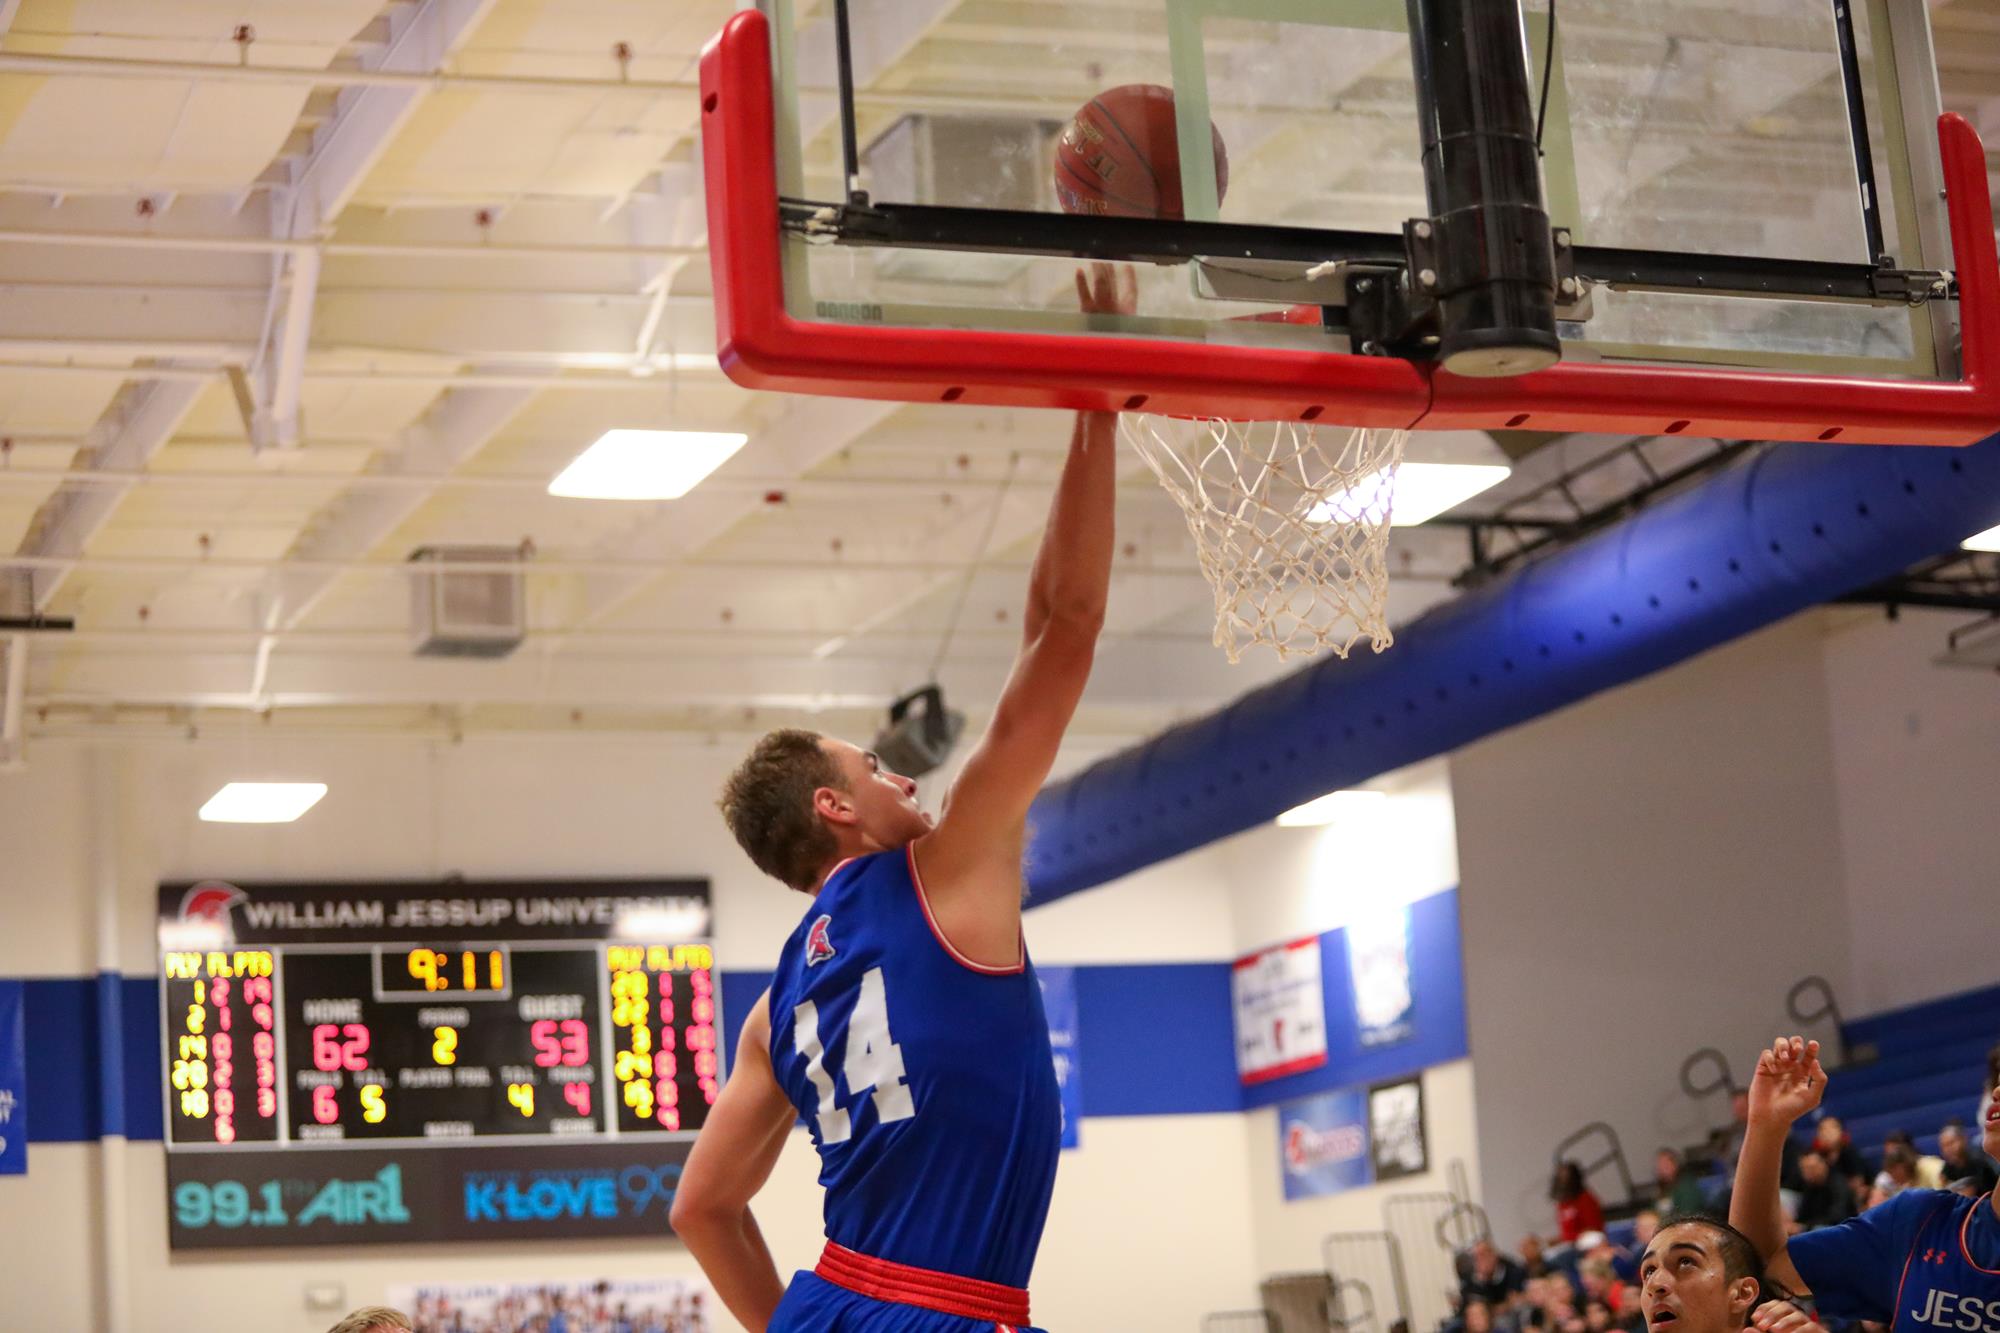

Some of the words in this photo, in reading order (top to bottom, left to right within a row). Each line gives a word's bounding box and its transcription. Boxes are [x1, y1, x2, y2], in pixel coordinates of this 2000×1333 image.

[245, 901, 384, 928] WILLIAM
[388, 898, 512, 927] JESSUP
[408, 948, 503, 992] 9:11
[194, 979, 205, 1004] 1
[210, 977, 230, 1007] 2
[519, 994, 584, 1021] GUEST
[186, 1004, 206, 1034] 2
[219, 1006, 231, 1031] 1
[212, 1032, 232, 1060] 0
[253, 1032, 274, 1060] 0
[313, 1024, 370, 1071] 62
[432, 1026, 458, 1065] 2
[531, 1019, 588, 1067] 53
[793, 967, 915, 1144] 14
[214, 1088, 234, 1116] 0
[313, 1085, 339, 1124] 6
[360, 1084, 386, 1123] 5
[508, 1083, 534, 1117] 4
[564, 1081, 591, 1116] 4
[175, 1180, 288, 1228] 99.1
[464, 1178, 618, 1222] K-LOVE
[1911, 1288, 2000, 1333] JESS
